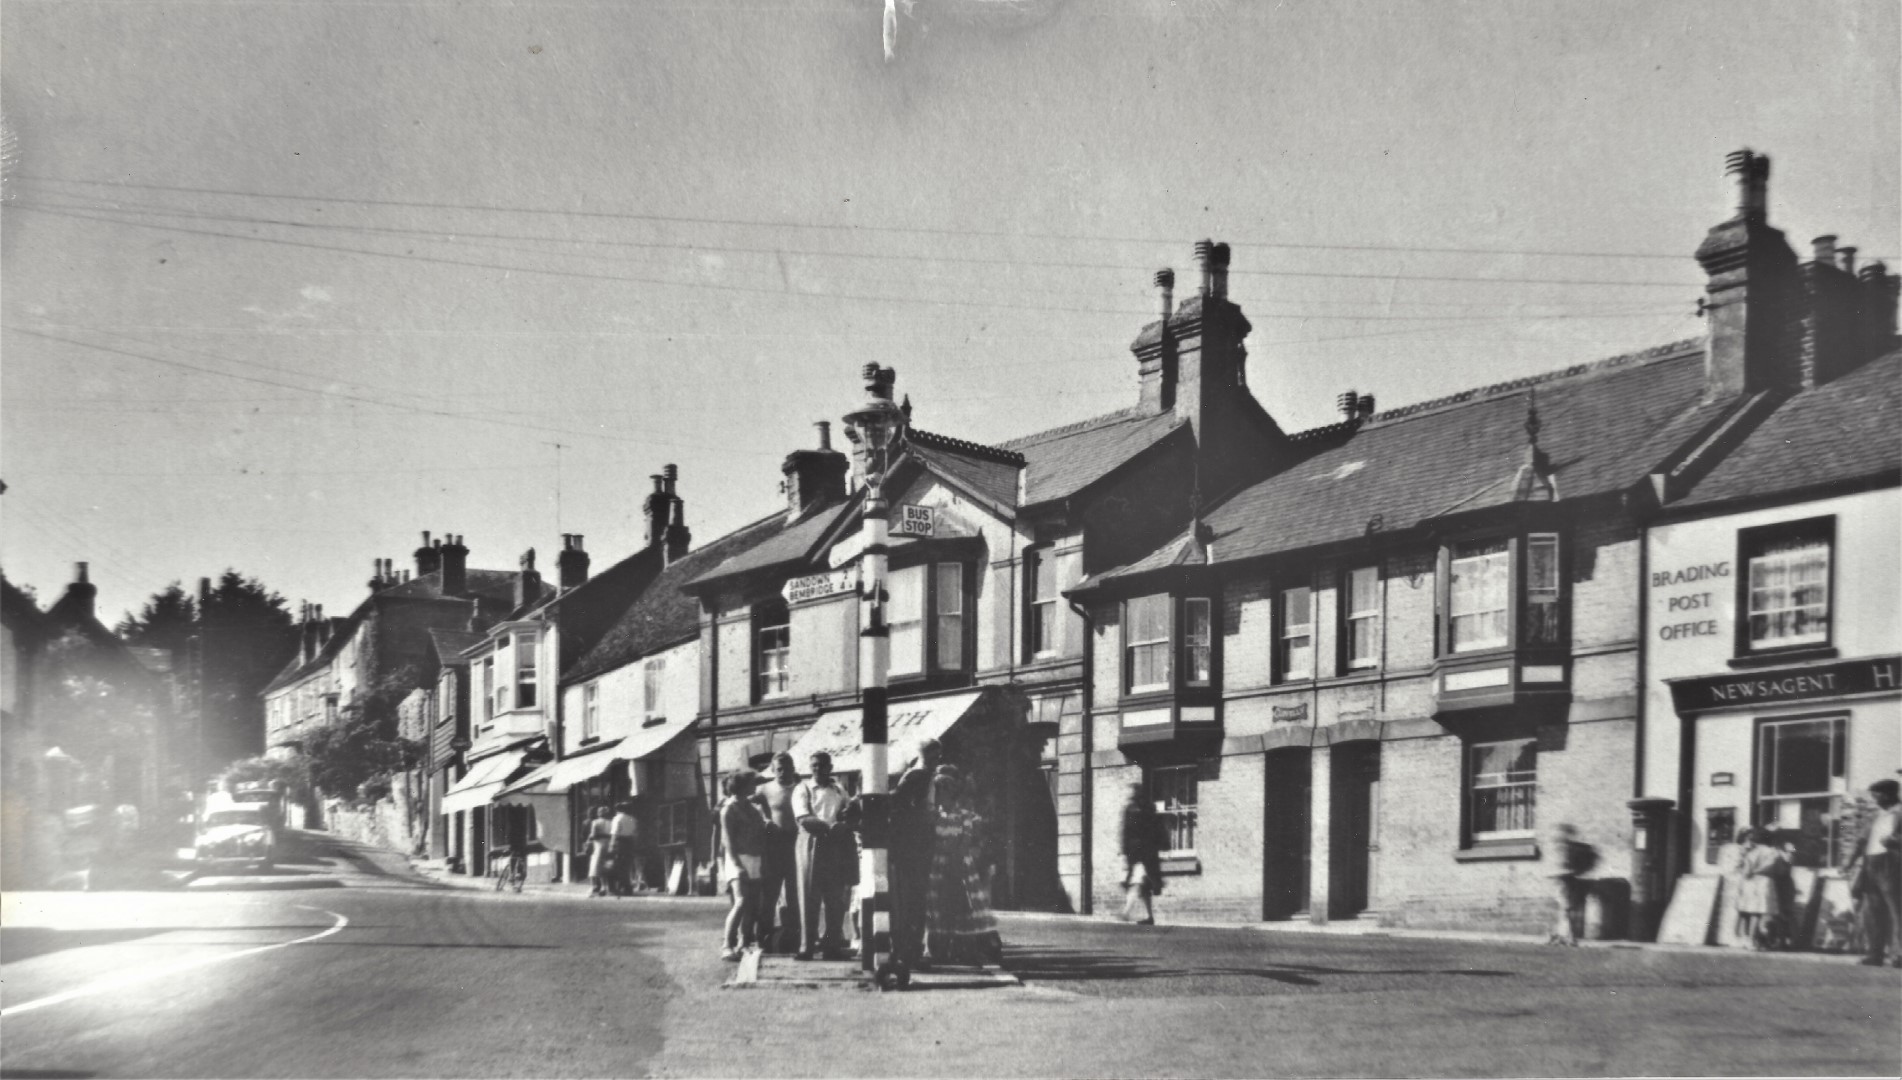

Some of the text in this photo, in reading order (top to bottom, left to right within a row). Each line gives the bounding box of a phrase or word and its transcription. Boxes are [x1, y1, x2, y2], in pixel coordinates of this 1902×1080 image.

[907, 507, 930, 521] BUS
[905, 520, 932, 535] STOP
[789, 574, 830, 591] SANDOWN
[1652, 561, 1730, 587] BRADING
[789, 583, 834, 601] BEMBRIDGE
[1668, 592, 1713, 612] POST
[1659, 620, 1718, 640] OFFICE
[1710, 673, 1836, 701] NEWSAGENT
